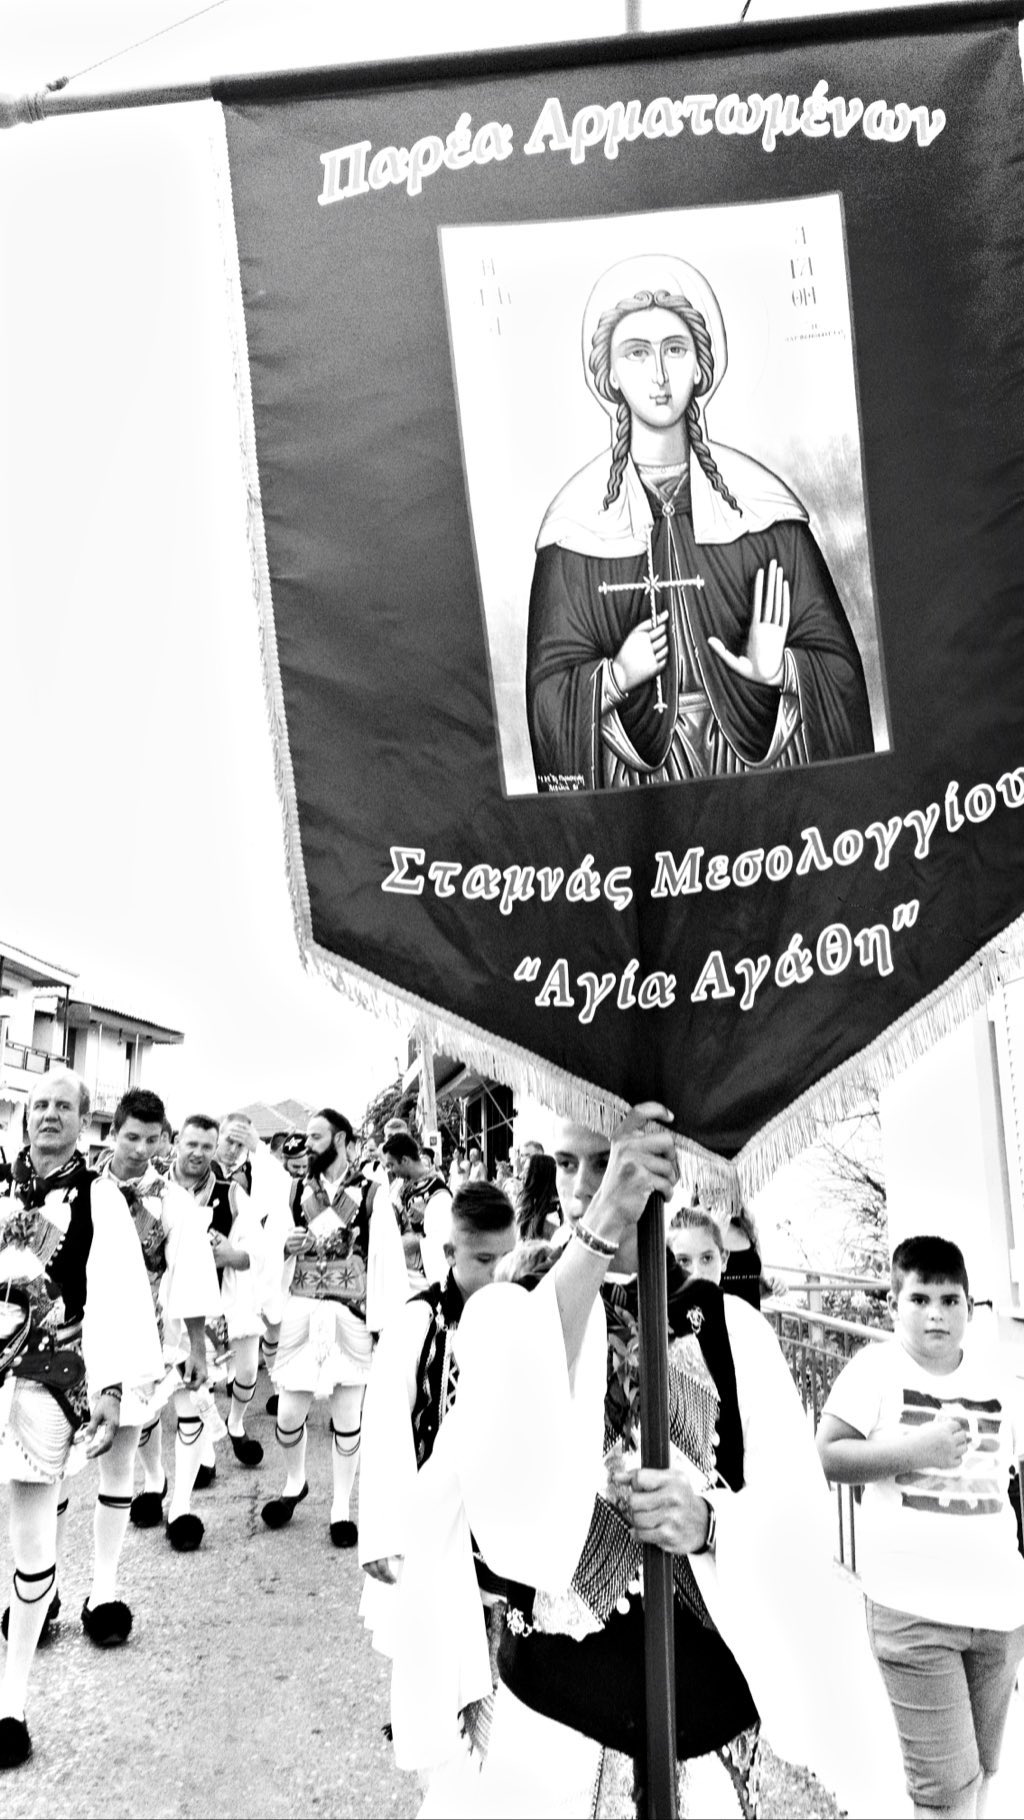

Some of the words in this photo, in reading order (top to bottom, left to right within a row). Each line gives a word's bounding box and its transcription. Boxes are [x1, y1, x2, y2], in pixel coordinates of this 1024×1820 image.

[316, 111, 514, 207] Παρέα
[523, 79, 947, 166] Αρματωμένων
[381, 846, 633, 915] Σταμνάς
[650, 766, 1024, 898] Μεσολογγίου
